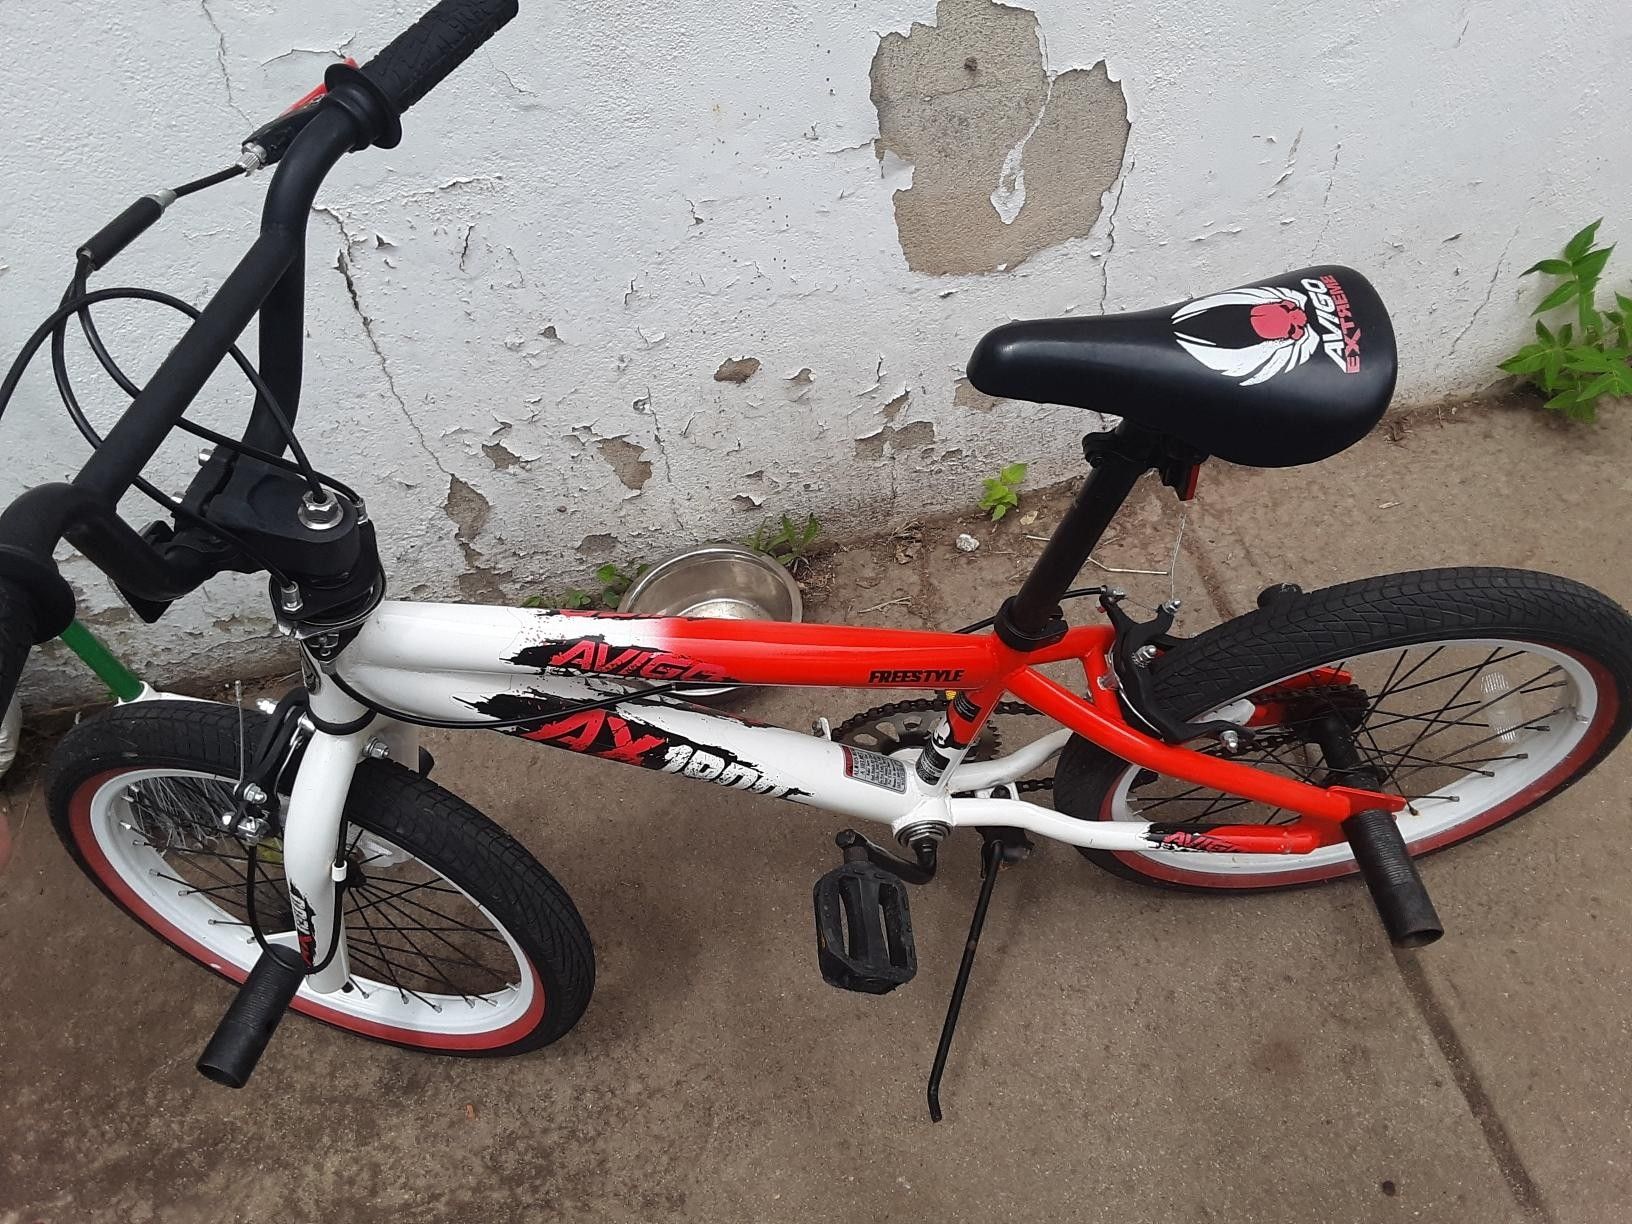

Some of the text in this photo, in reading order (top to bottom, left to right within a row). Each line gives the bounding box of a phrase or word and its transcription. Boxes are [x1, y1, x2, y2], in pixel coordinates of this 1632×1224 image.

[1300, 277, 1348, 374] AVIGO
[1319, 274, 1362, 374] EXTREME
[549, 639, 731, 683] AVIGO
[868, 669, 966, 684] FREESTYLE
